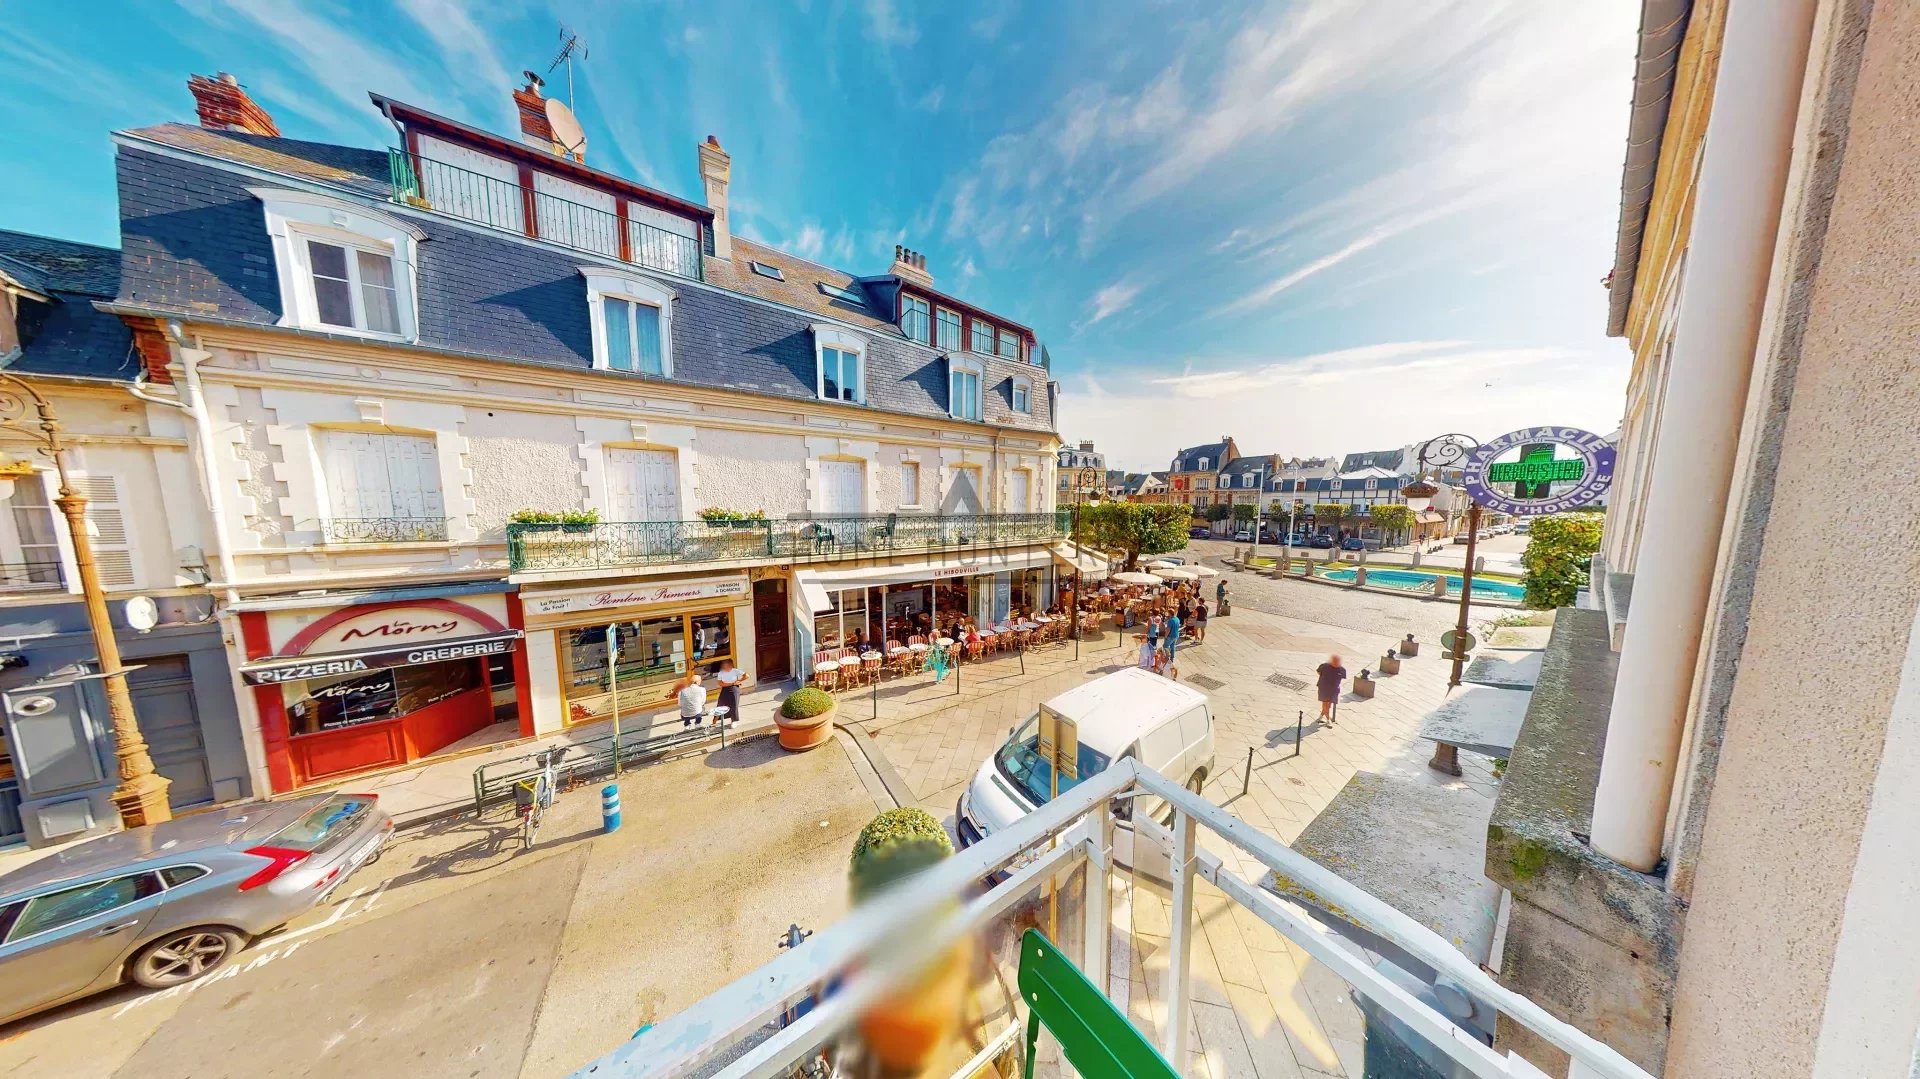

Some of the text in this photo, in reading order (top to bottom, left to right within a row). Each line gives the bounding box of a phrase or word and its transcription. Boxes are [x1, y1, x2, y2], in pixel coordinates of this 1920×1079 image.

[1466, 426, 1609, 485] PHARMACIE
[1487, 474, 1612, 514] DE L'HORLOGE
[651, 587, 701, 600] Primeurs
[340, 621, 458, 642] Morny
[256, 641, 506, 684] PIZZERIA CREPERIE
